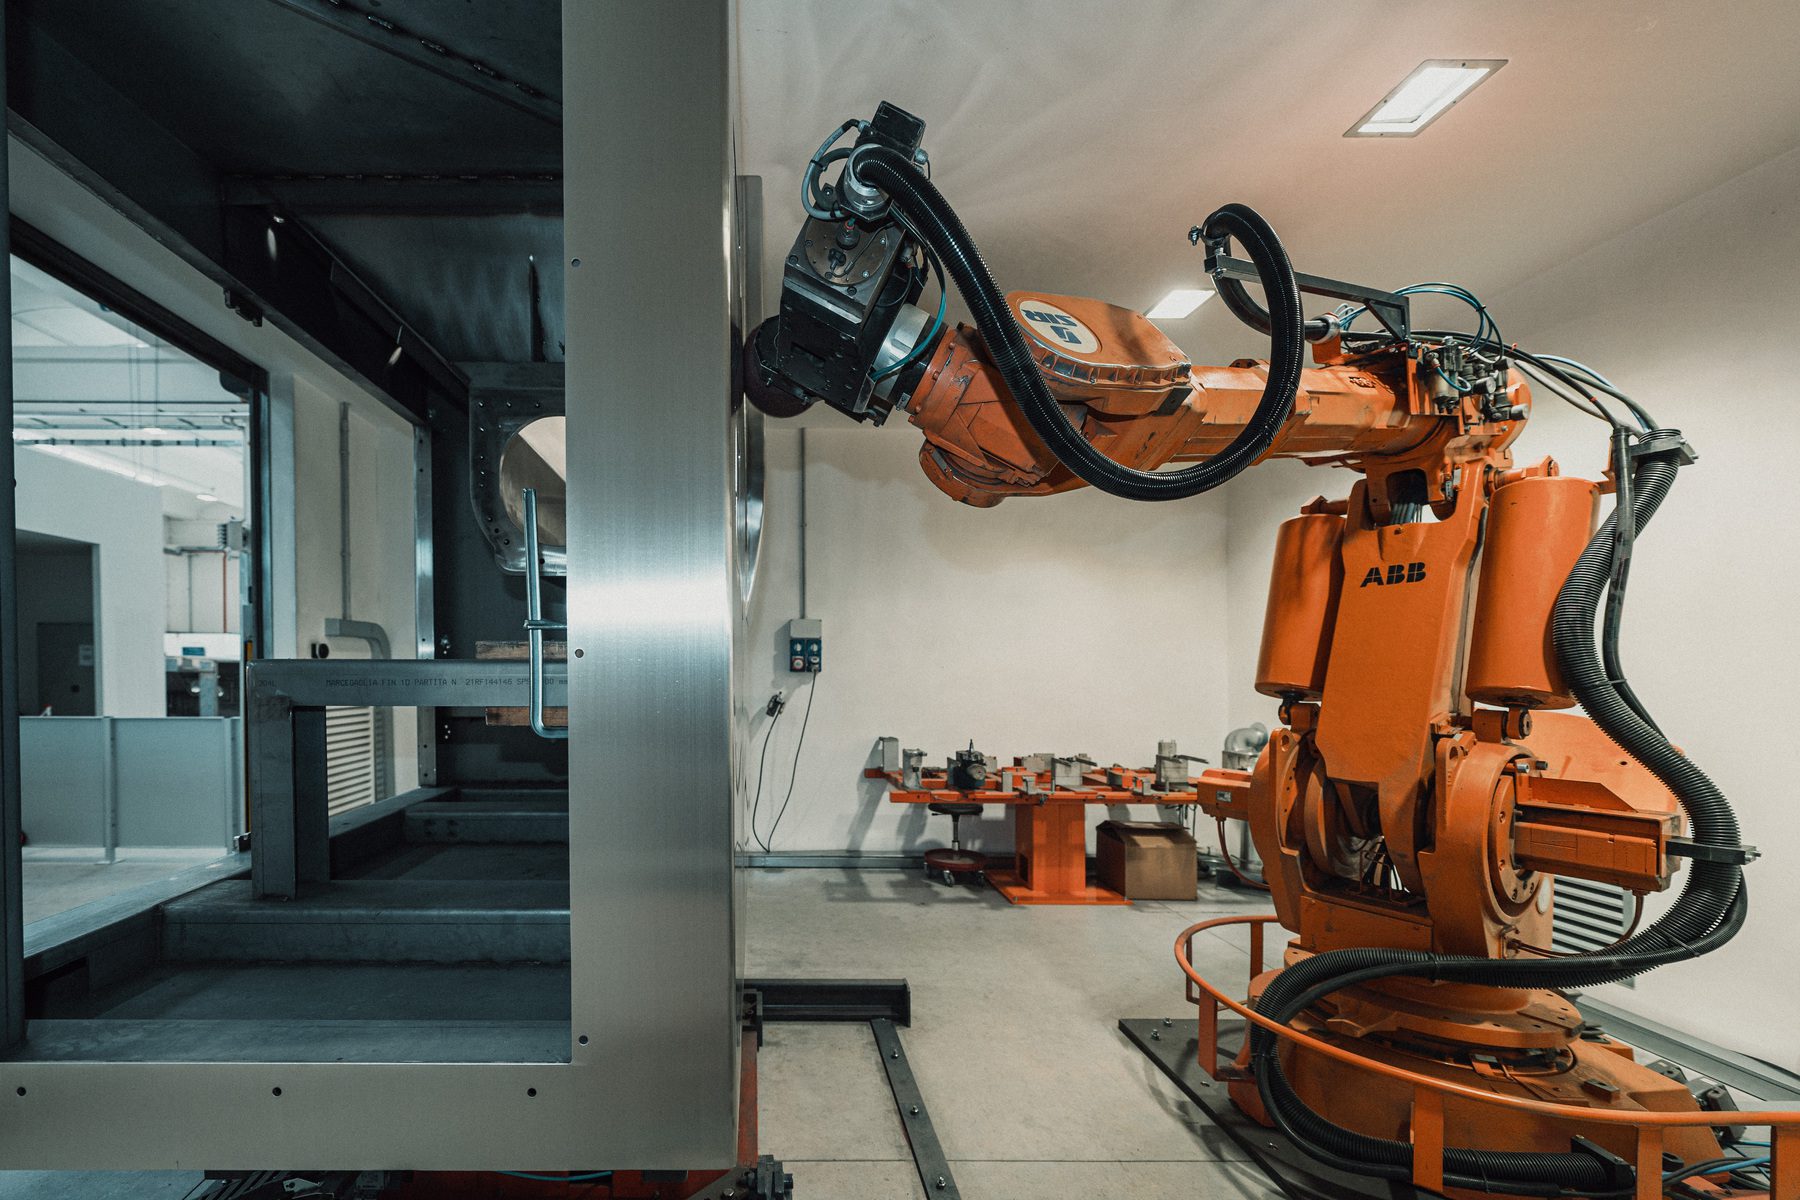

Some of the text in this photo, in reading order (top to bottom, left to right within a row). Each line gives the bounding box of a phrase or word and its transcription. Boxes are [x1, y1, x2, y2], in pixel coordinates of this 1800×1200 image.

[1021, 308, 1078, 327] SIR
[1360, 562, 1427, 588] ABB
[414, 678, 448, 686] PARTITA
